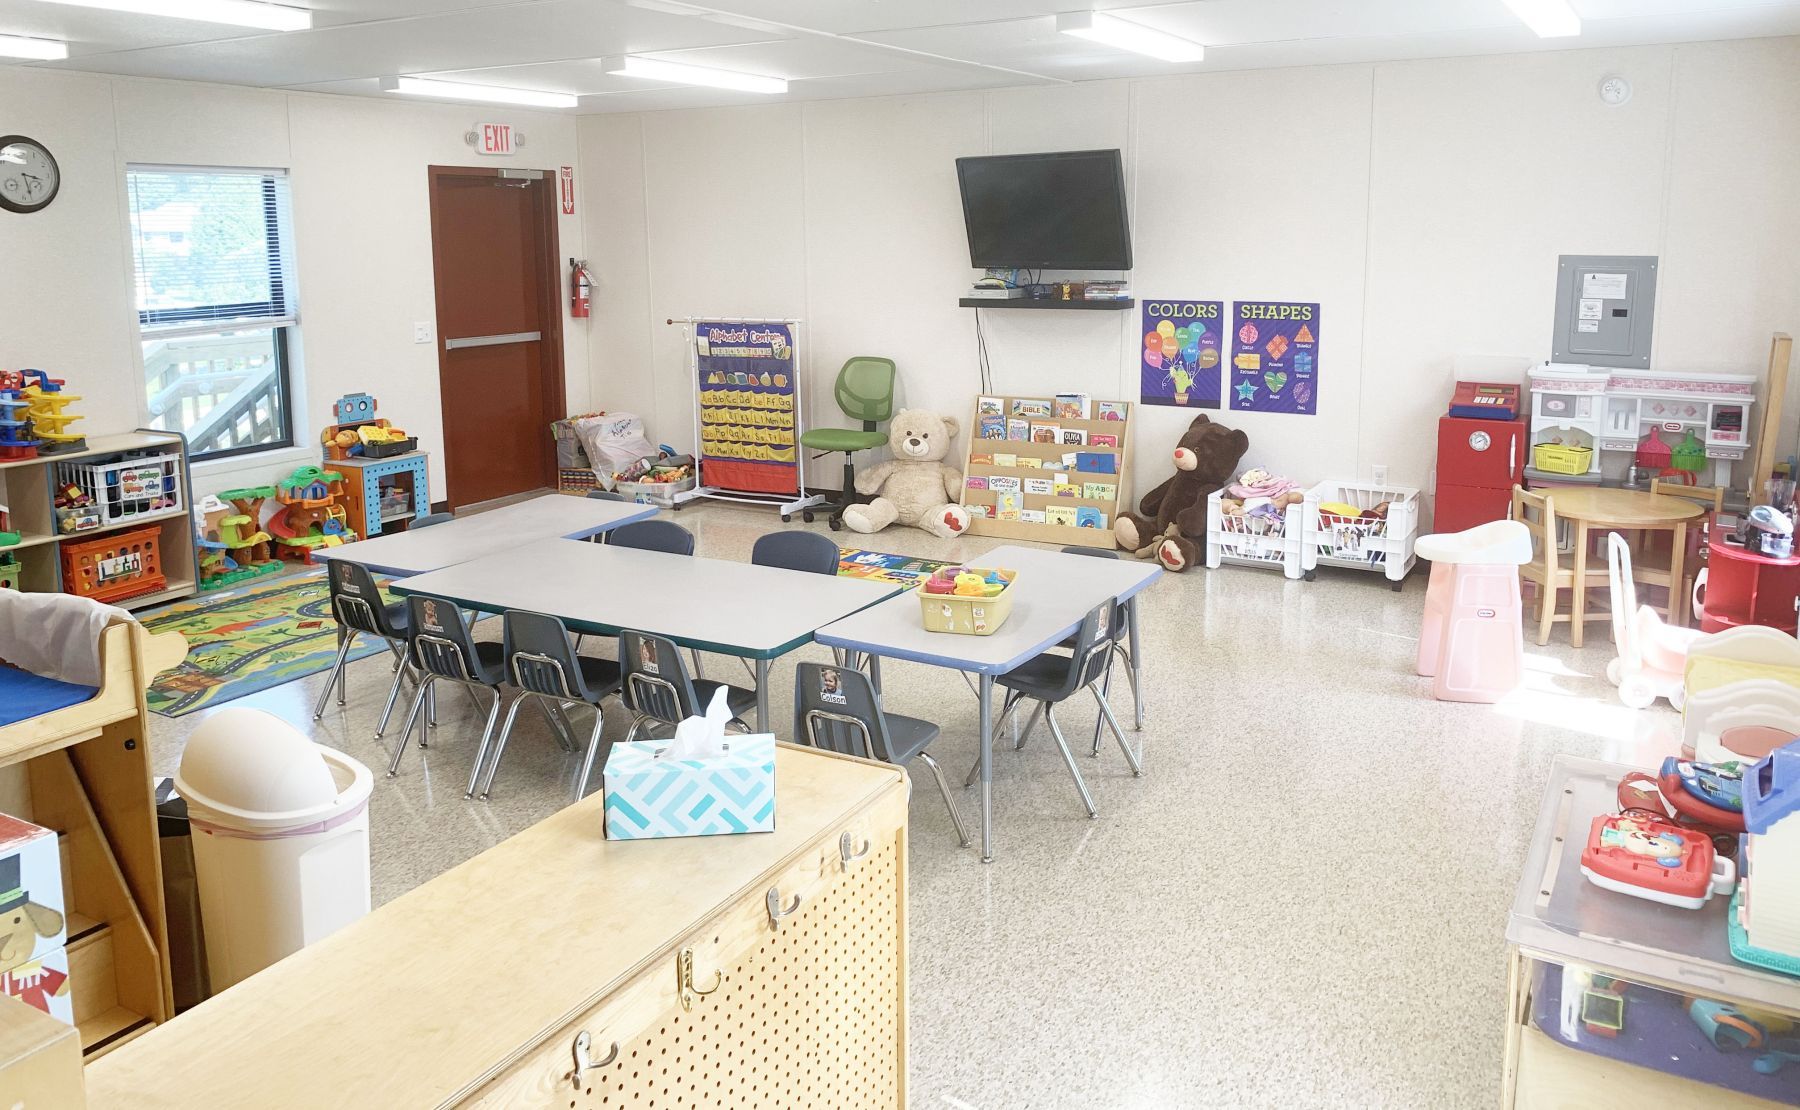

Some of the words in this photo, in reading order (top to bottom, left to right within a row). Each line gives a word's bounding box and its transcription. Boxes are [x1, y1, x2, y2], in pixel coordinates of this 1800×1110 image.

[484, 124, 510, 152] EXIT
[1148, 303, 1218, 318] COLORS
[1240, 304, 1312, 321] SHAPES
[710, 328, 748, 343] Alphabet
[713, 395, 725, 403] Bb
[101, 554, 140, 579] LEGO
[821, 693, 846, 704] Colson
